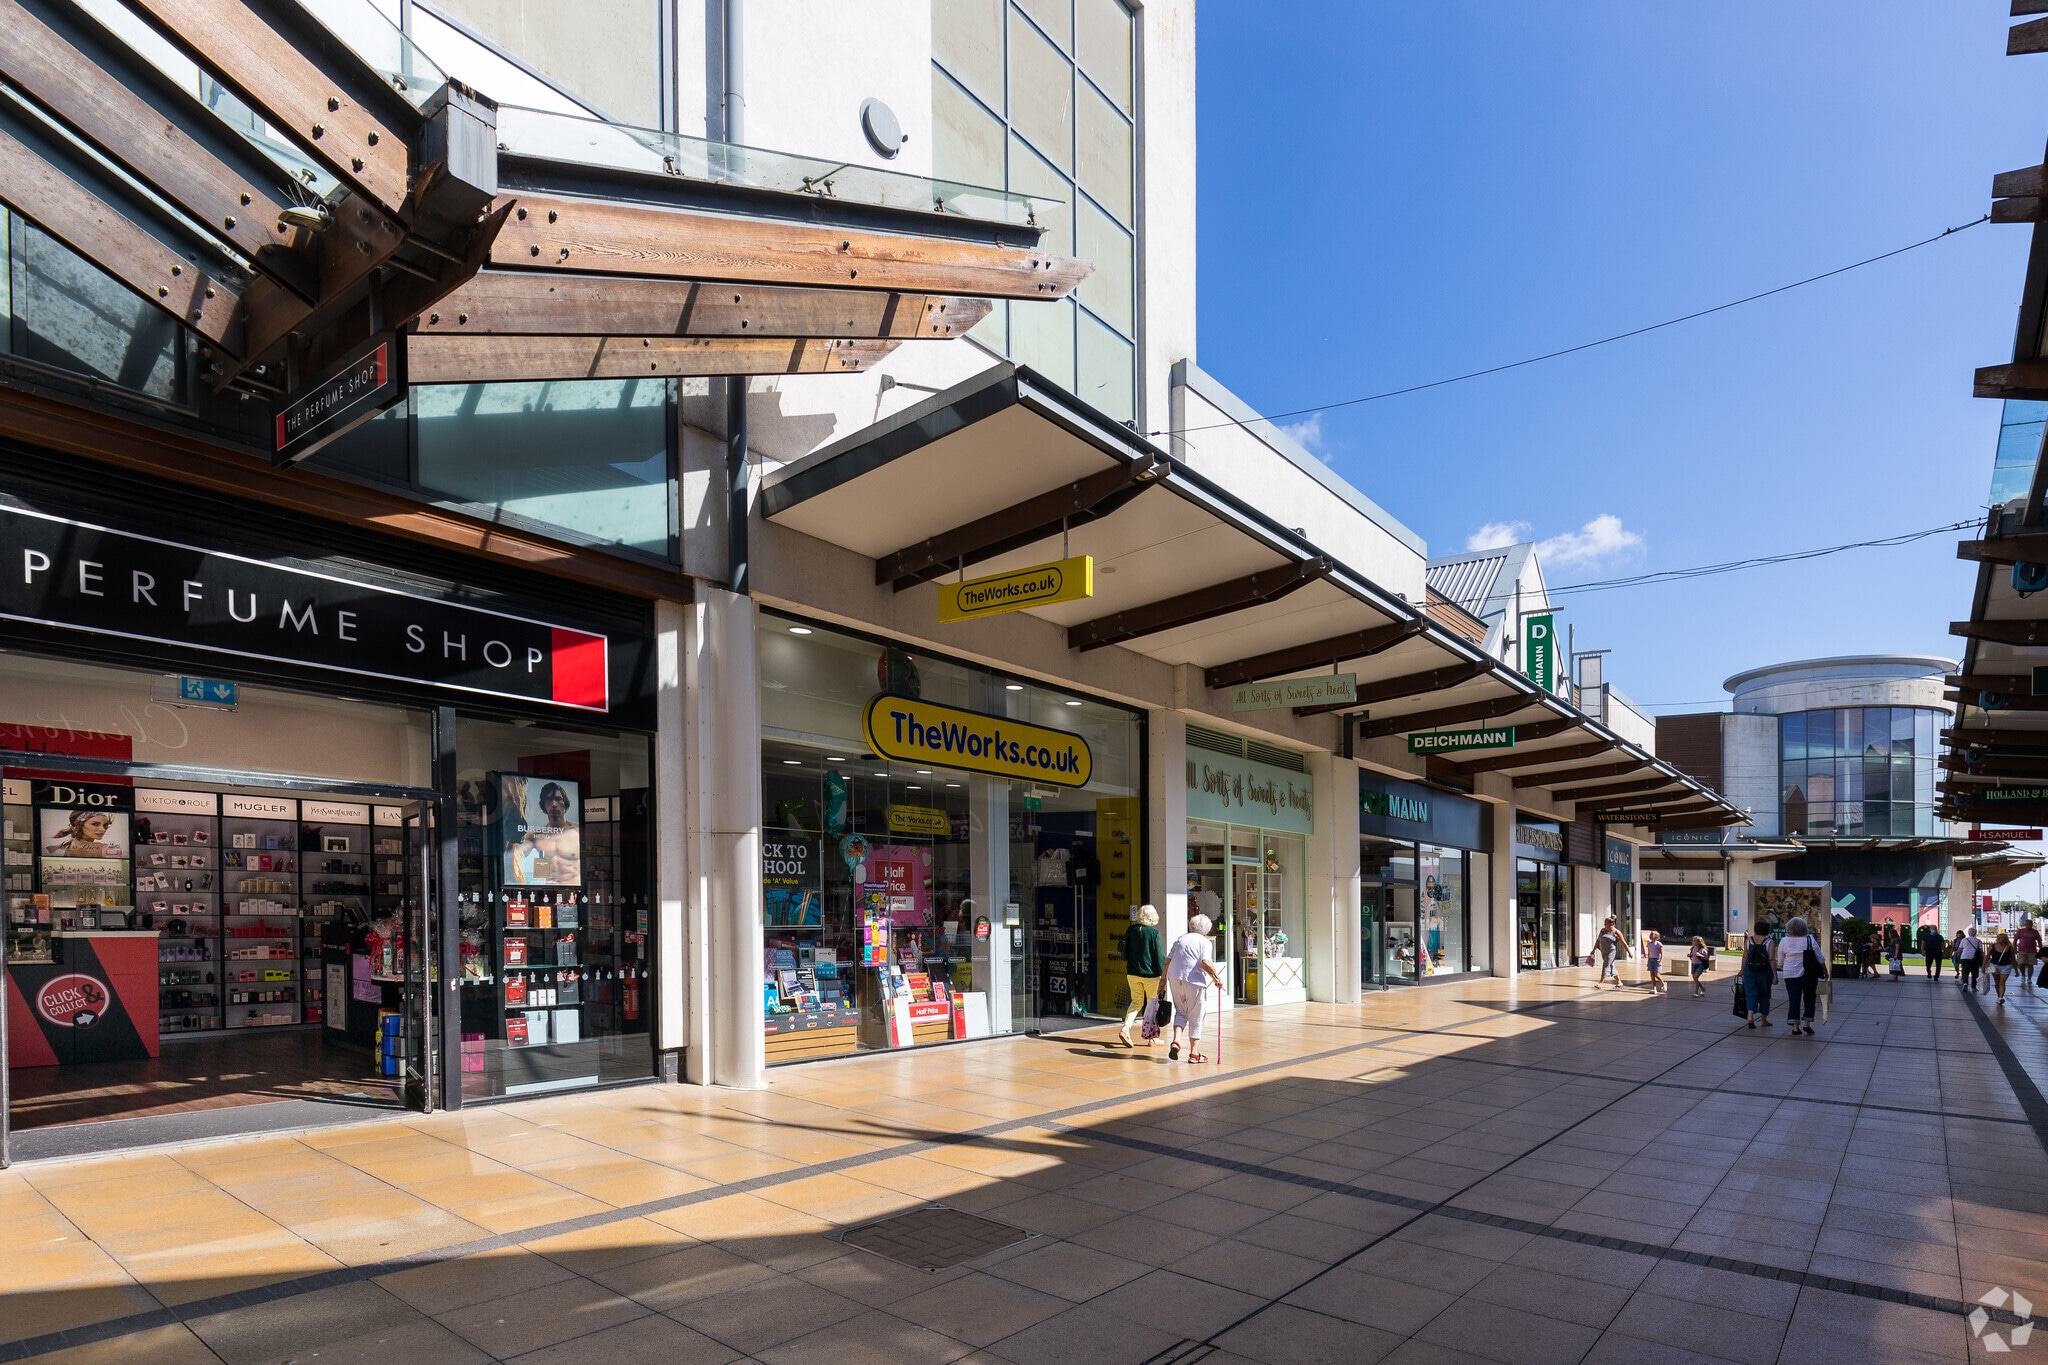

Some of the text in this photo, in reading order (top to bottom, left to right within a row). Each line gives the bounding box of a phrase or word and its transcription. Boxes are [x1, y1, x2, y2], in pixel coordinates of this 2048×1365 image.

[287, 365, 374, 433] THE PERFUME SHOP
[964, 575, 1056, 606] TheWorks.co.uk
[24, 548, 543, 674] PERFUME SHOP
[1531, 624, 1548, 640] D
[1236, 690, 1247, 704] All
[1250, 689, 1273, 706] Sorts
[1274, 687, 1283, 704] of
[1286, 685, 1315, 703] Sweets
[1325, 681, 1353, 700] Treats
[889, 710, 1080, 775] TheWorks.co.uk
[1414, 732, 1507, 748] DEICHMANN
[50, 785, 118, 807] Dior
[1203, 764, 1231, 808] Sorts
[1233, 773, 1245, 808] of
[1247, 774, 1279, 816] Sweets
[1986, 789, 2030, 800] HOLLAND
[2031, 789, 2041, 798] &
[233, 802, 287, 813] MUGLER
[1598, 813, 1657, 821] WATERSTONE'S
[517, 824, 565, 835] BURBERRY
[1979, 831, 2031, 839] H.SAMUEL
[787, 845, 807, 859] TO
[884, 866, 905, 879] Half
[1050, 978, 1066, 992] £6
[43, 983, 103, 1007] CLICK &
[49, 997, 88, 1017] COLLECT
[916, 1007, 939, 1016] Half Price
